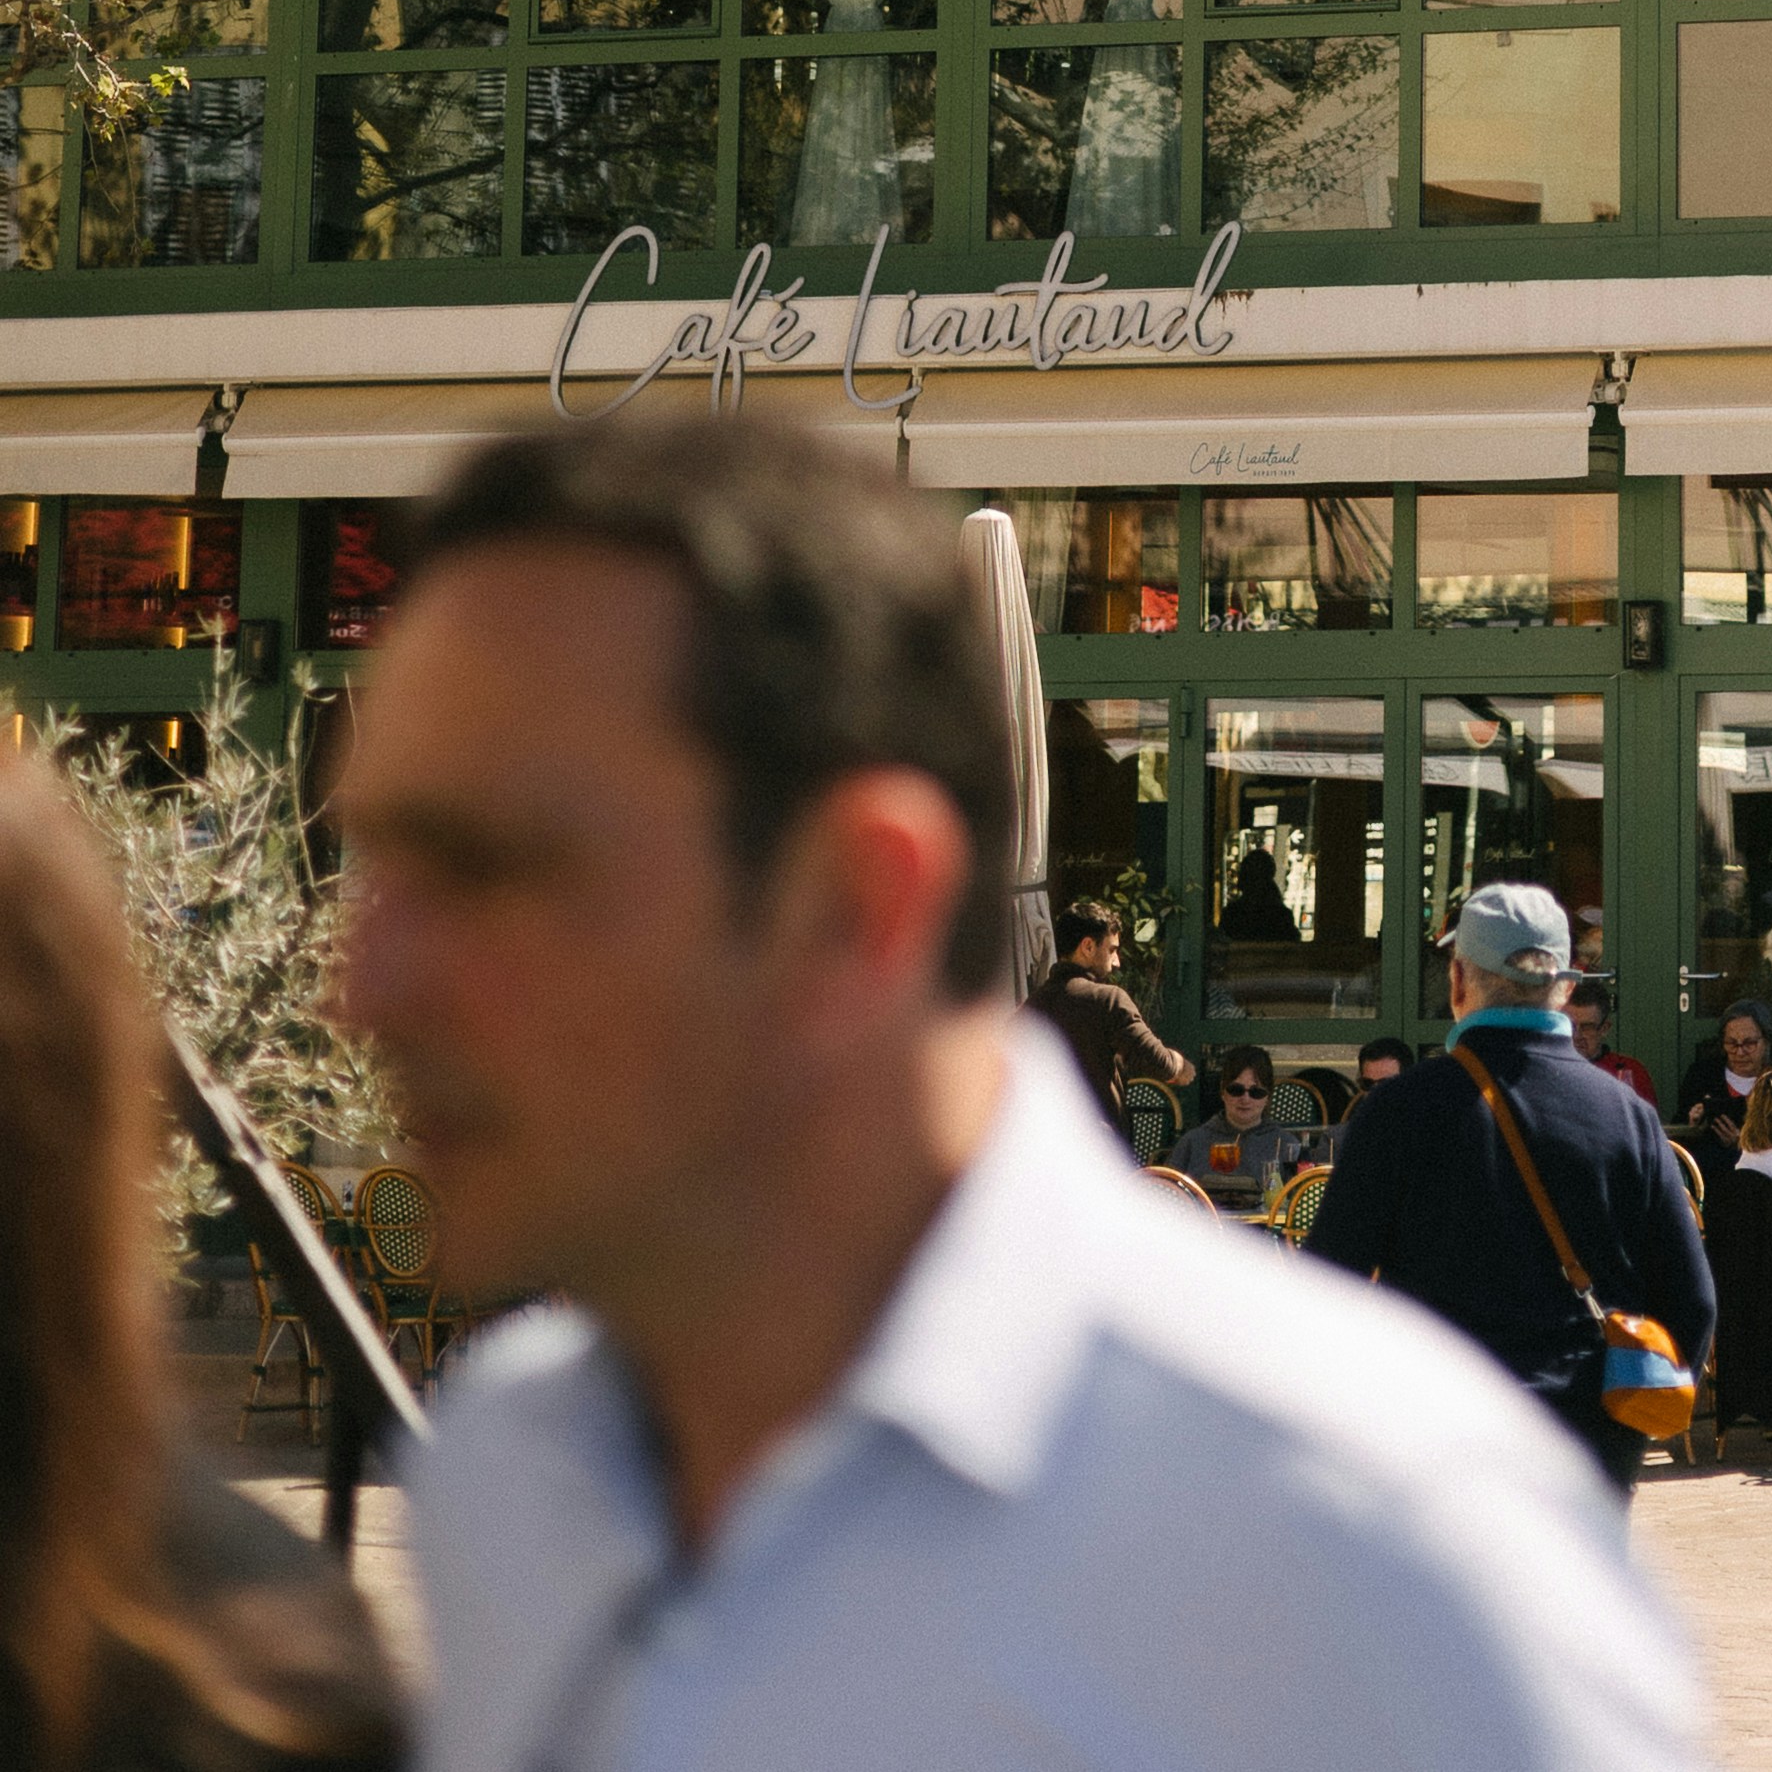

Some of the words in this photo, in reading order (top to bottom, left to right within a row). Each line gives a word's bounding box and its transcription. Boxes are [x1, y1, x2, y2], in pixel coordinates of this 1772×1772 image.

[550, 225, 815, 422] Café
[844, 220, 1242, 410] Liautaud
[1189, 442, 1232, 476] Café
[1237, 442, 1301, 473] Liautaud
